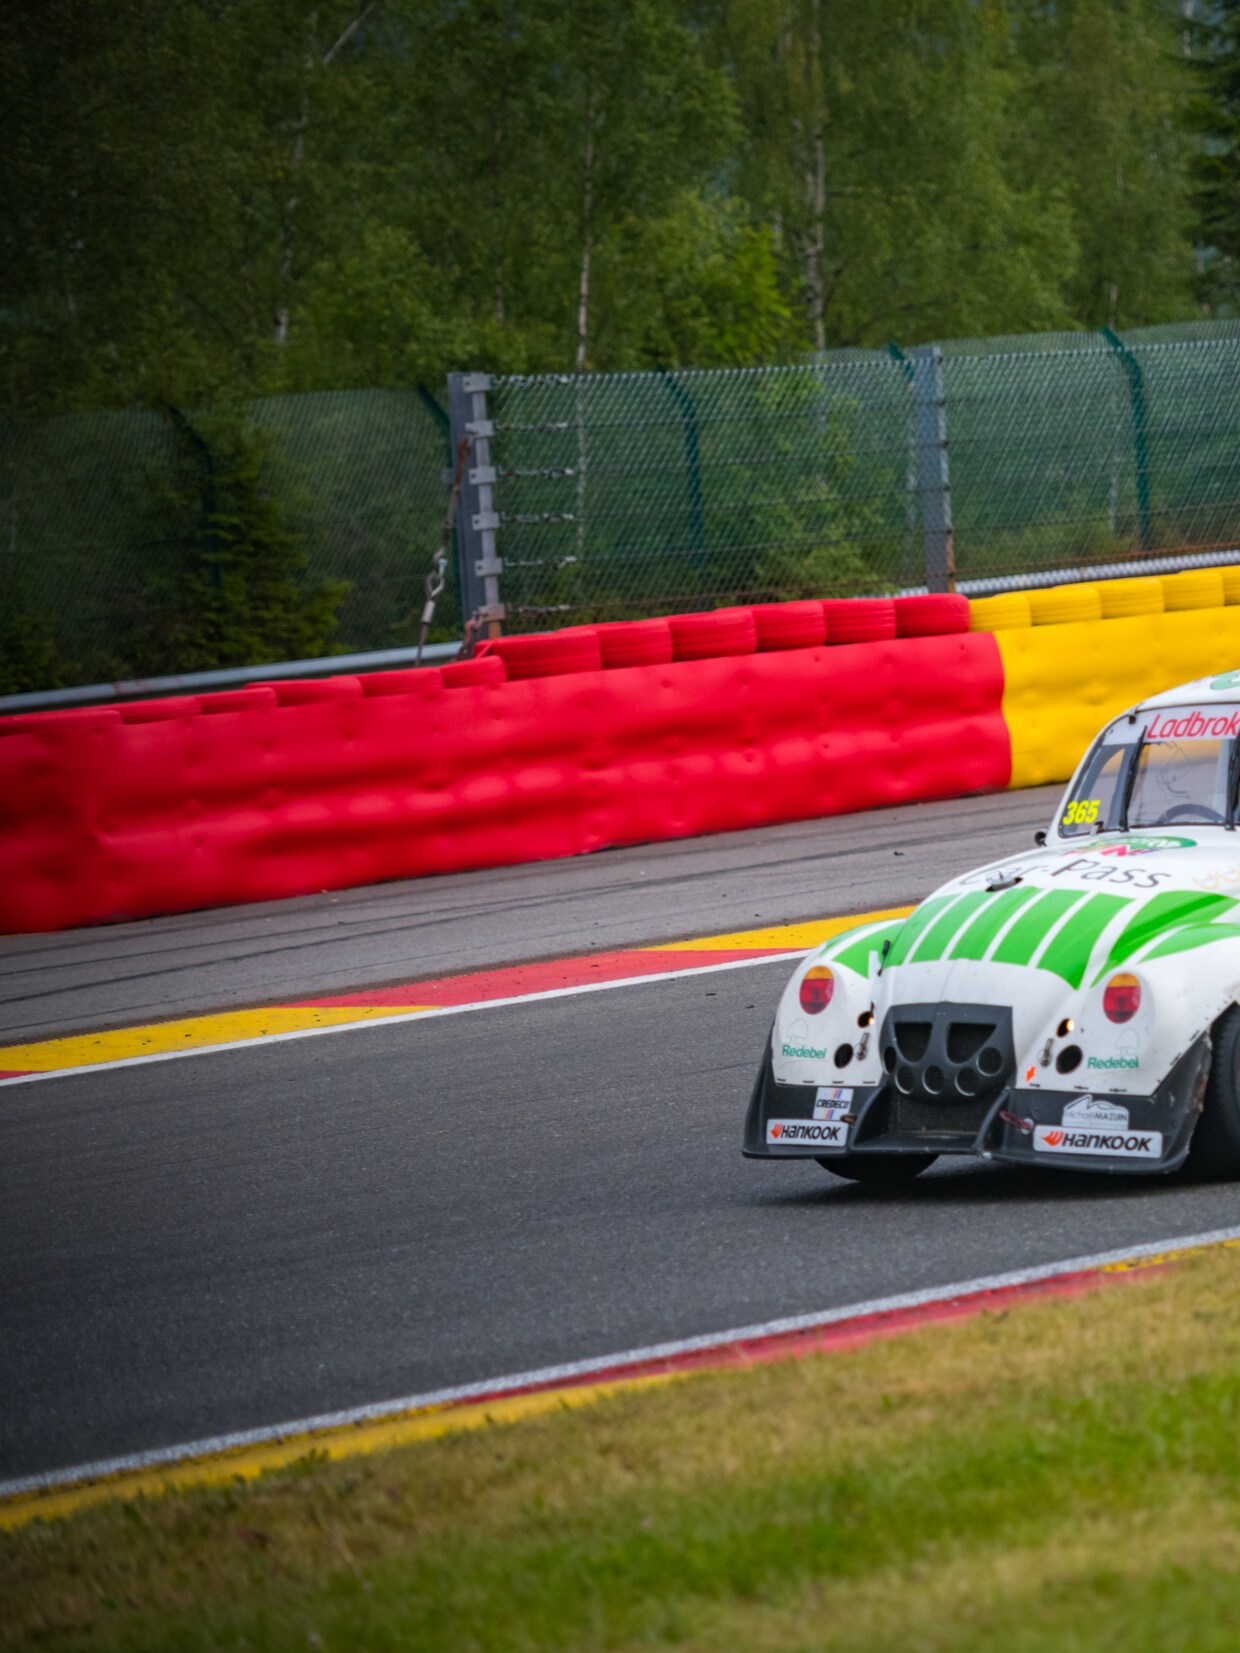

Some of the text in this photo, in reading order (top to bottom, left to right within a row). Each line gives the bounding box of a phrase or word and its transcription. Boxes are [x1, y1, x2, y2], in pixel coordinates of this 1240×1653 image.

[1062, 799, 1100, 826] 365
[782, 1044, 827, 1059] Redebel
[1087, 1056, 1139, 1069] Redebel
[816, 1098, 850, 1109] CREDECO
